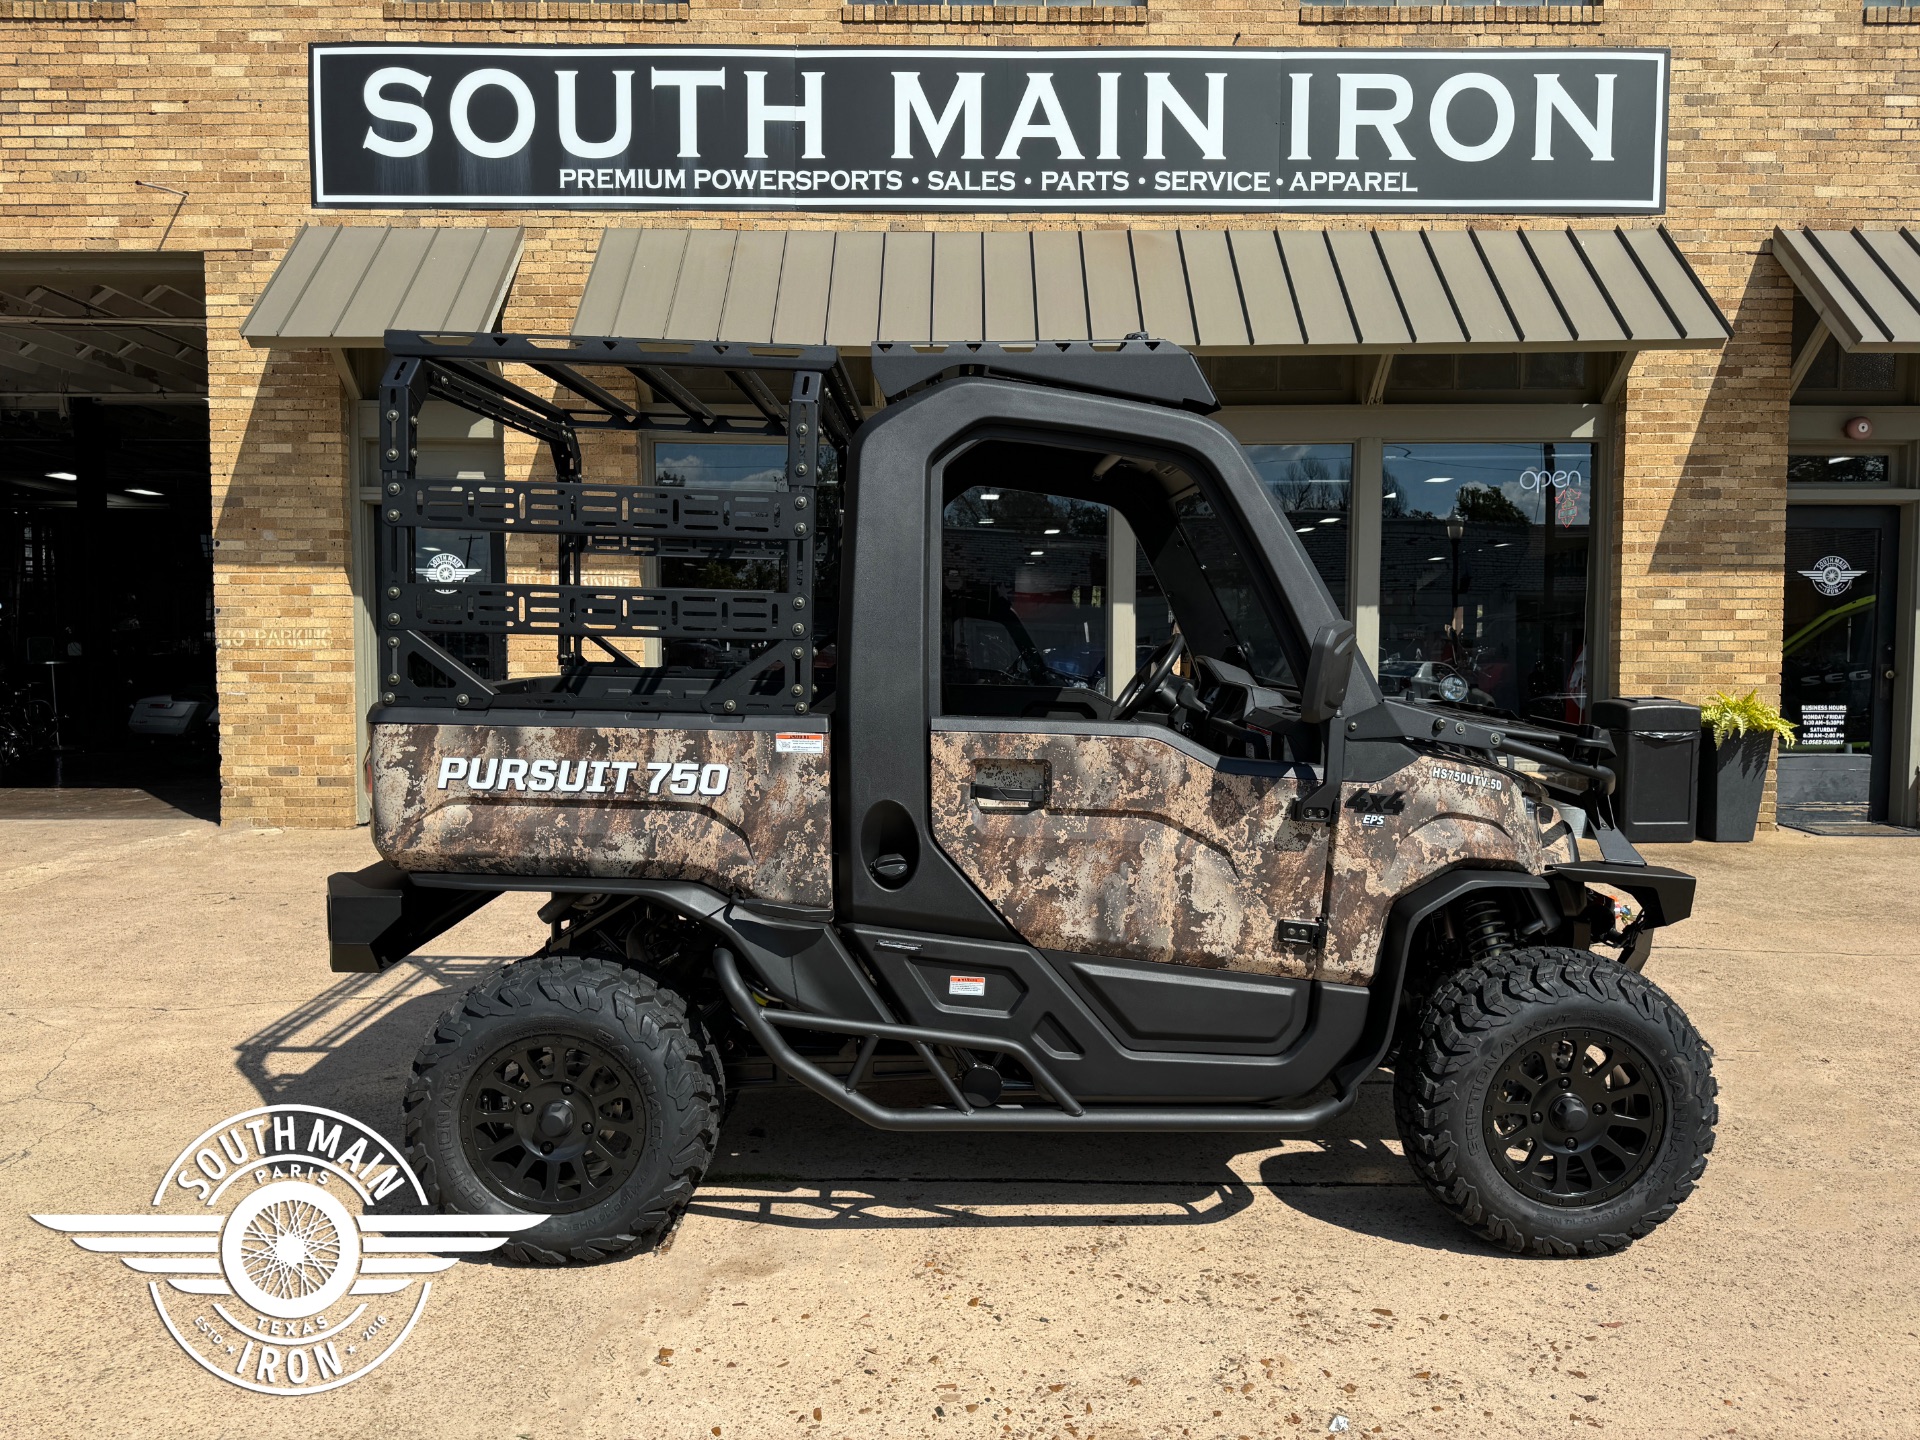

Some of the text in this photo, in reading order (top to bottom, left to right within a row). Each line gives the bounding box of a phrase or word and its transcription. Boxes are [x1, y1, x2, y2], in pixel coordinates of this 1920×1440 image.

[362, 66, 1618, 162] SOUTH MAIN IRON
[558, 168, 1418, 193] PREMIUM POWERSPORTS SALES PARTS SERVICE APPAREL
[1519, 470, 1582, 494] open
[430, 554, 462, 568] SOUTH MAIN
[1816, 556, 1848, 570] SOUTH MAIN
[218, 629, 333, 647] NO PARKING
[437, 757, 730, 796] PURSUIT 750
[1362, 814, 1385, 825] EPS
